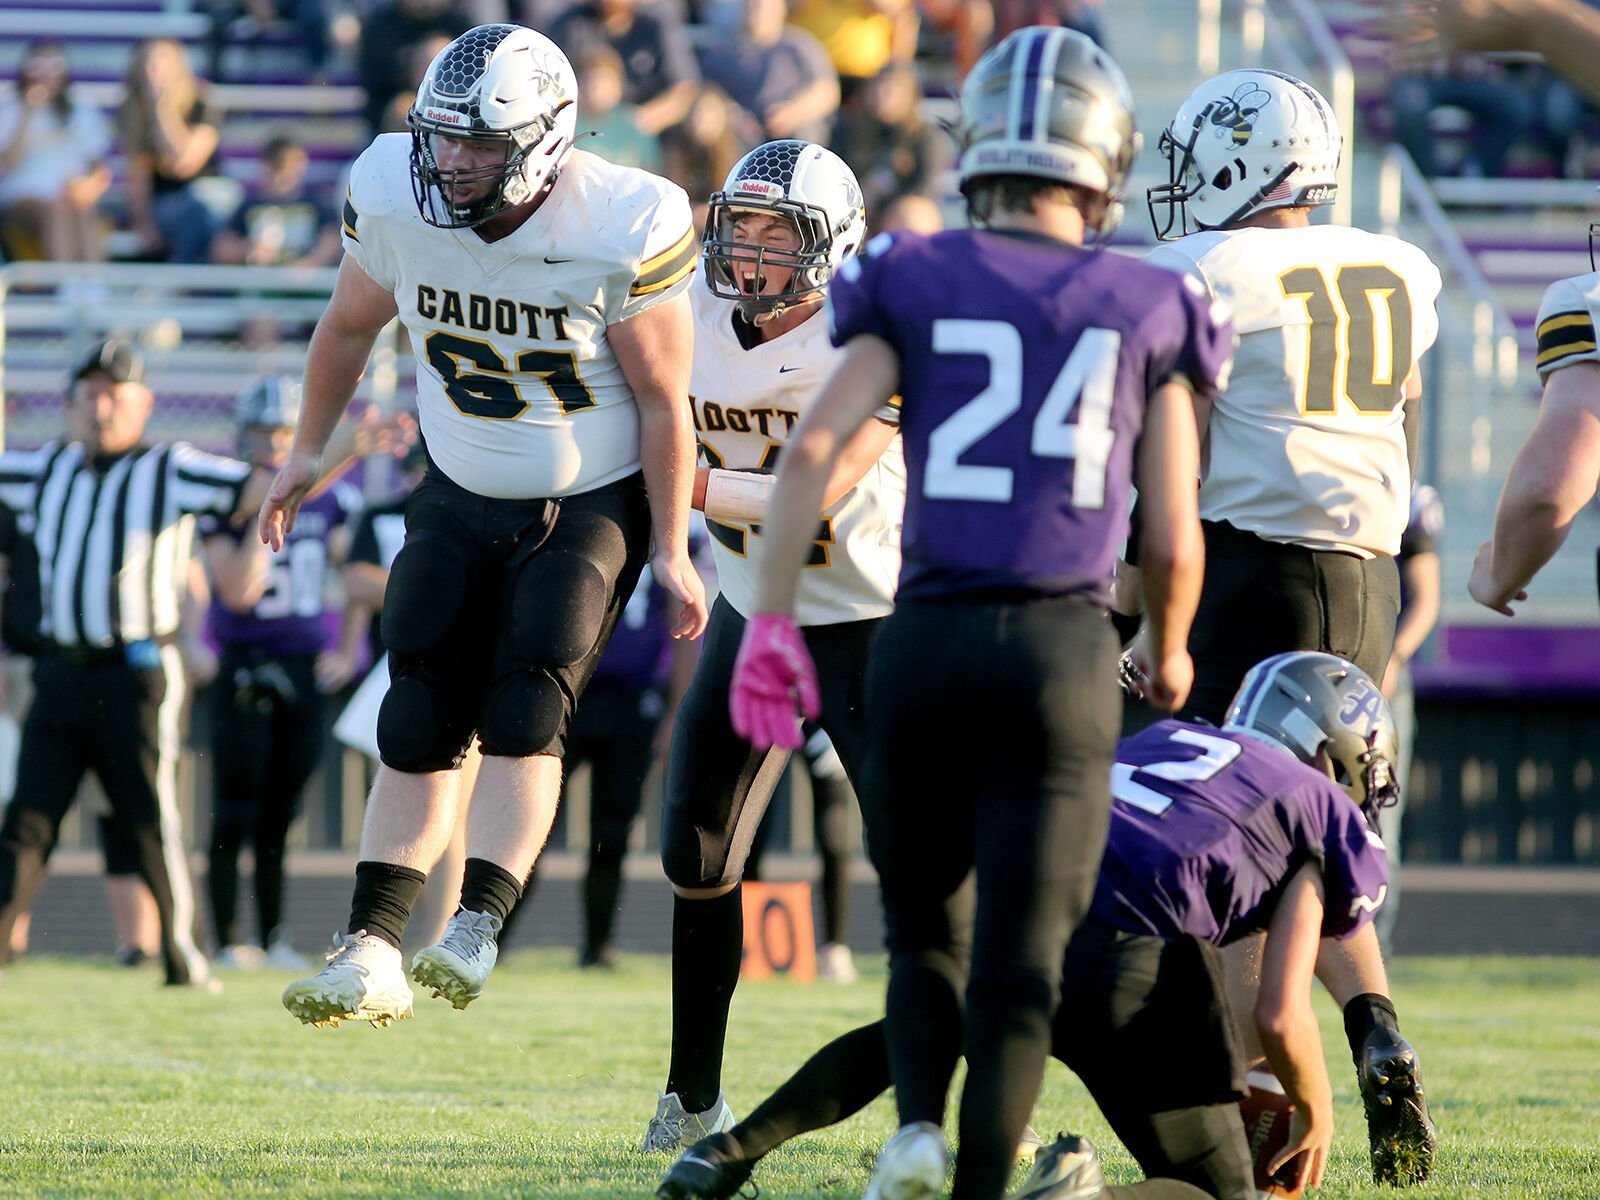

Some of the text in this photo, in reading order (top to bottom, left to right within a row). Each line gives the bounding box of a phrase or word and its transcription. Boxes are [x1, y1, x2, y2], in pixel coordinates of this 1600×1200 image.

[427, 109, 460, 124] Riddell
[742, 182, 769, 193] Riddell
[417, 284, 570, 341] CADOTT
[1276, 262, 1413, 416] 10
[424, 329, 600, 422] 61
[923, 318, 1122, 509] 24
